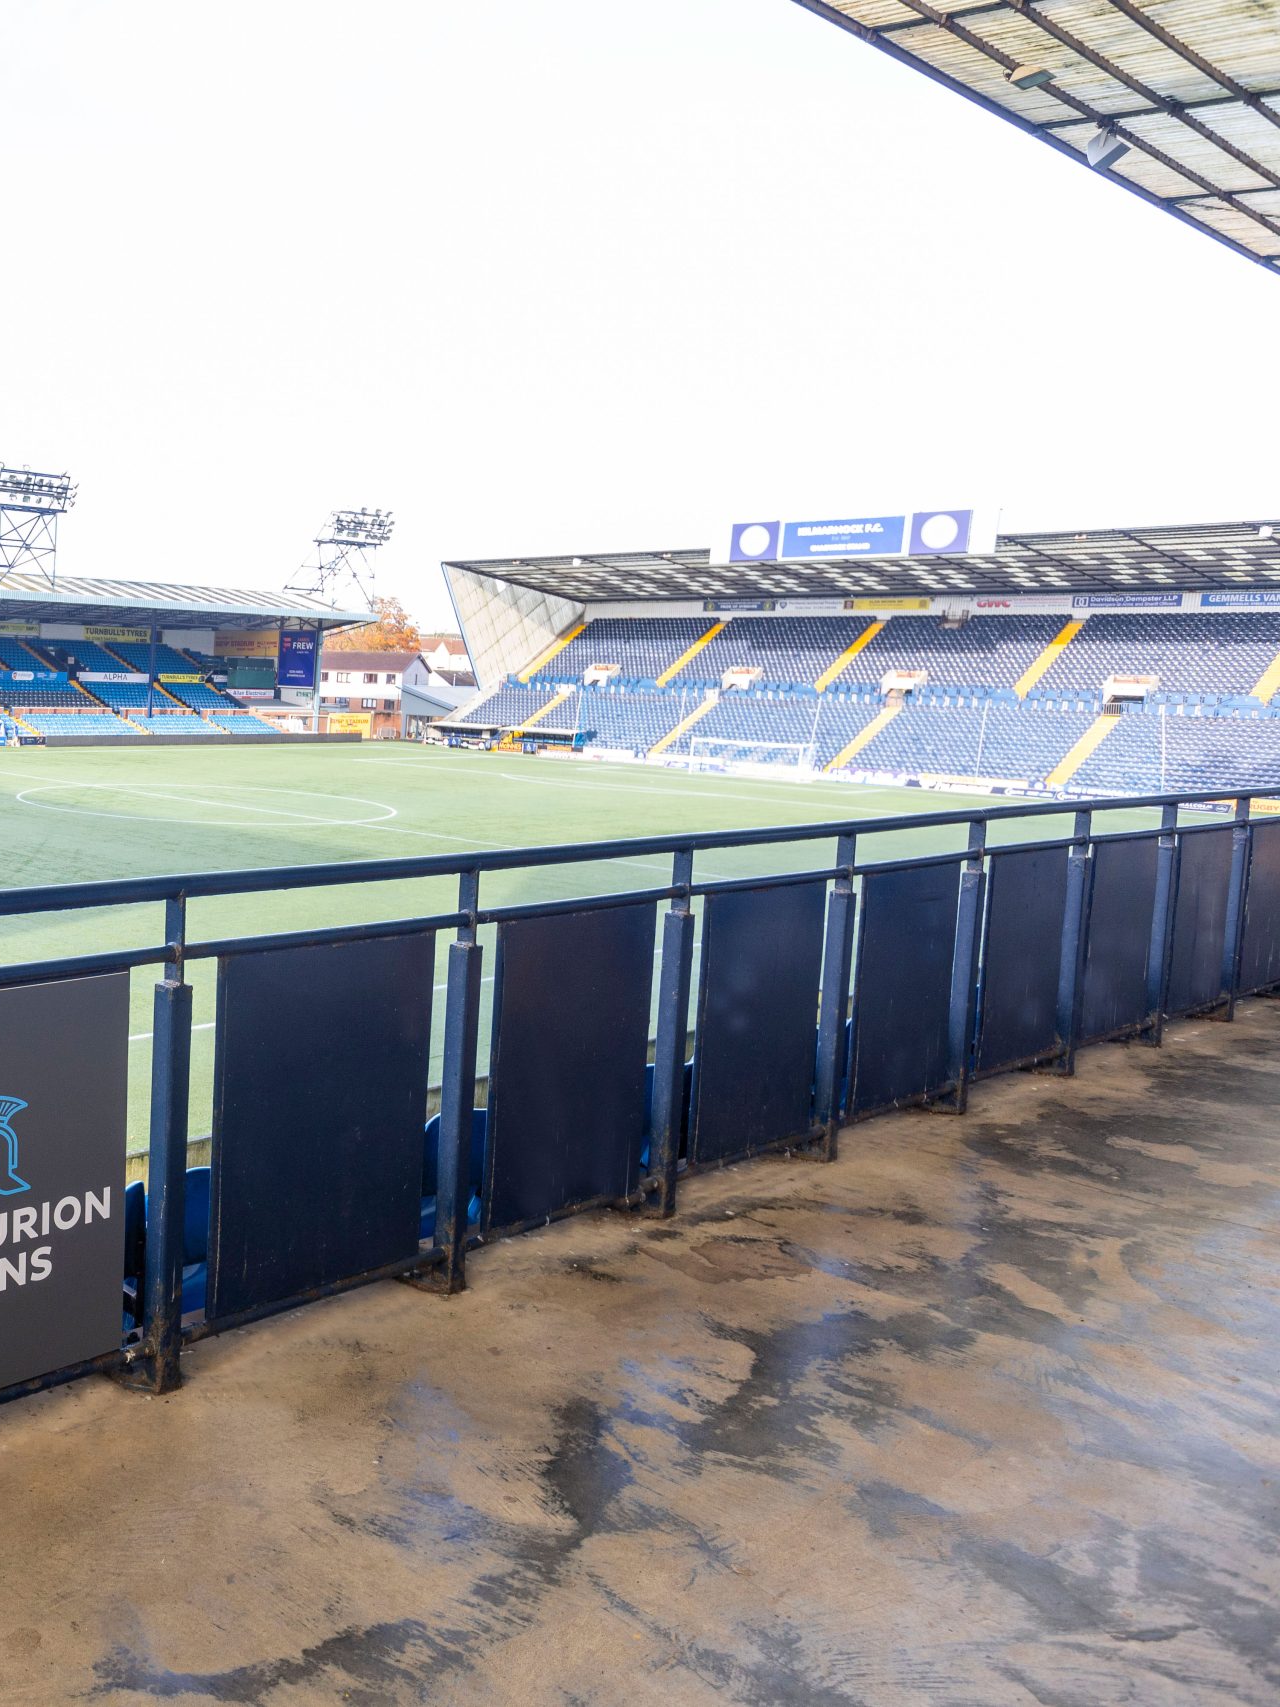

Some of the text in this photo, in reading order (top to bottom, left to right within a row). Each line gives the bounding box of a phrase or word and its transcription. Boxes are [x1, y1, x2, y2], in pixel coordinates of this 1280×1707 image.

[1125, 595, 1162, 603] Dempster
[1208, 594, 1261, 602] GEMMELLS
[85, 627, 148, 638] TURNBULL'S TYRES
[292, 642, 314, 650] FREW
[103, 673, 128, 681] ALPHA
